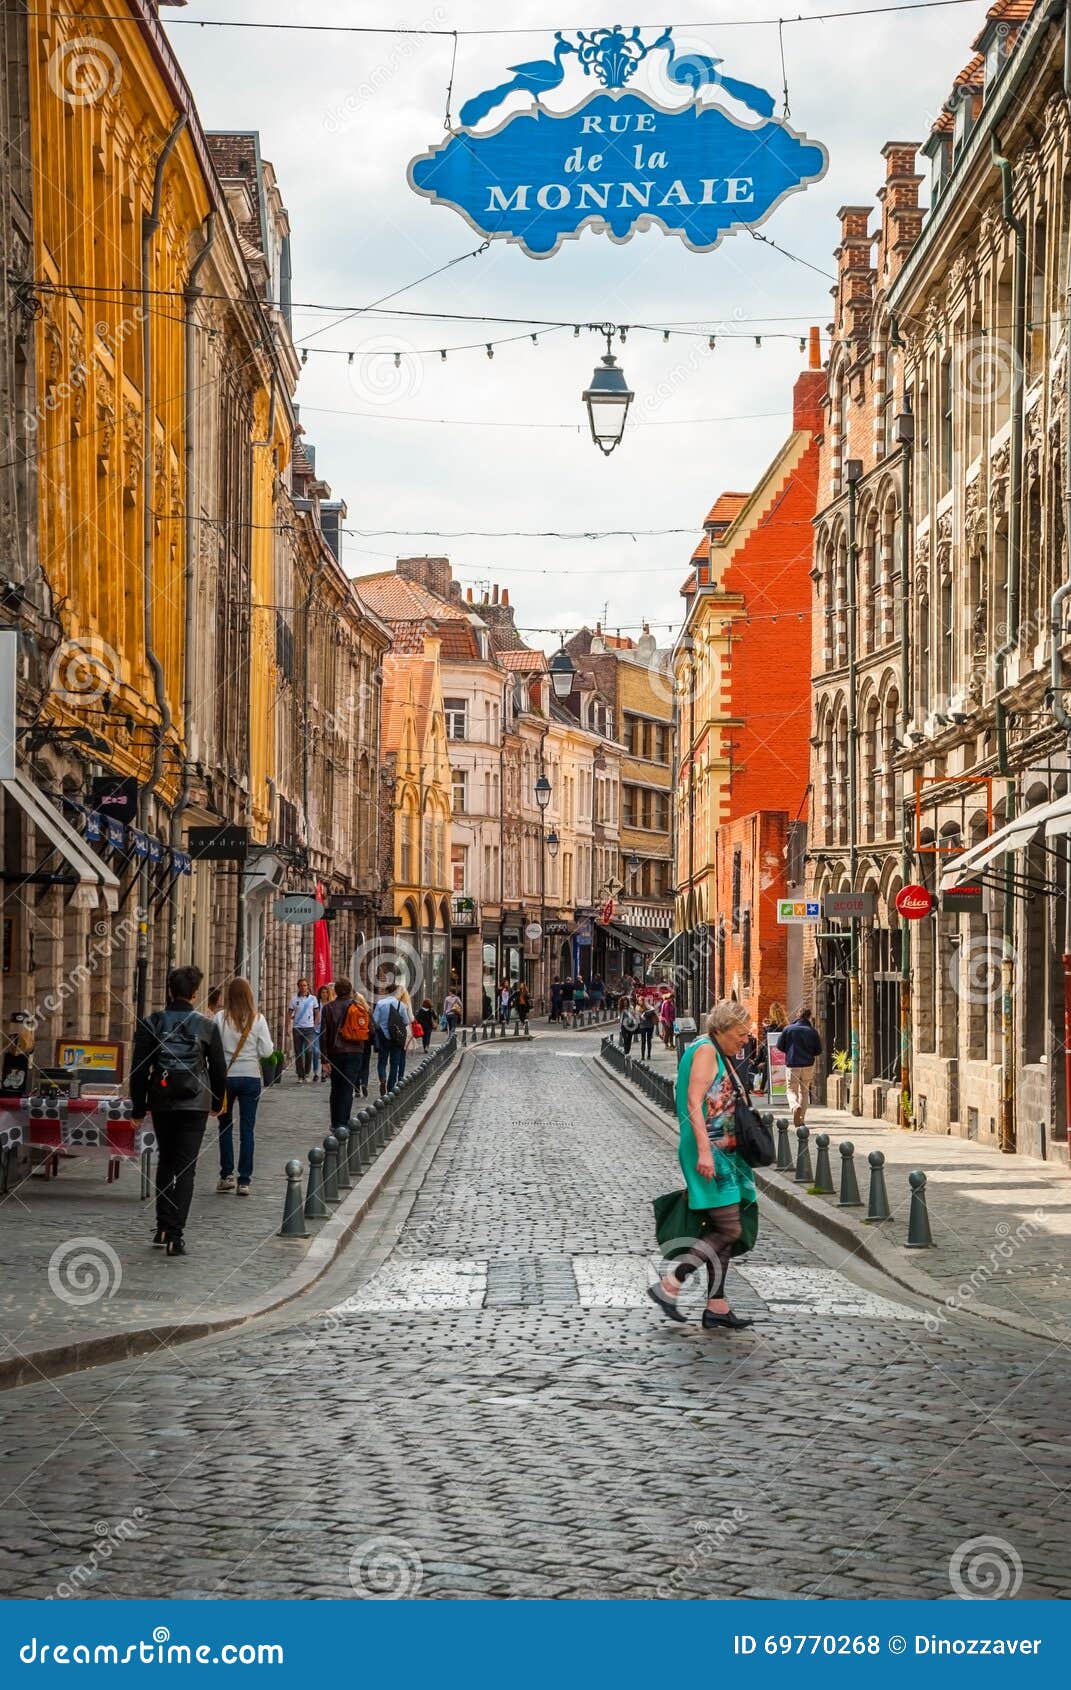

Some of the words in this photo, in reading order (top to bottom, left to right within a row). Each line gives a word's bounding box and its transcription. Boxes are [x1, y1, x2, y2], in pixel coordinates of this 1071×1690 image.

[579, 113, 656, 134] RUE
[563, 146, 603, 173] de
[632, 144, 669, 170] la
[483, 176, 755, 211] MONNAIE
[901, 895, 929, 909] Leica
